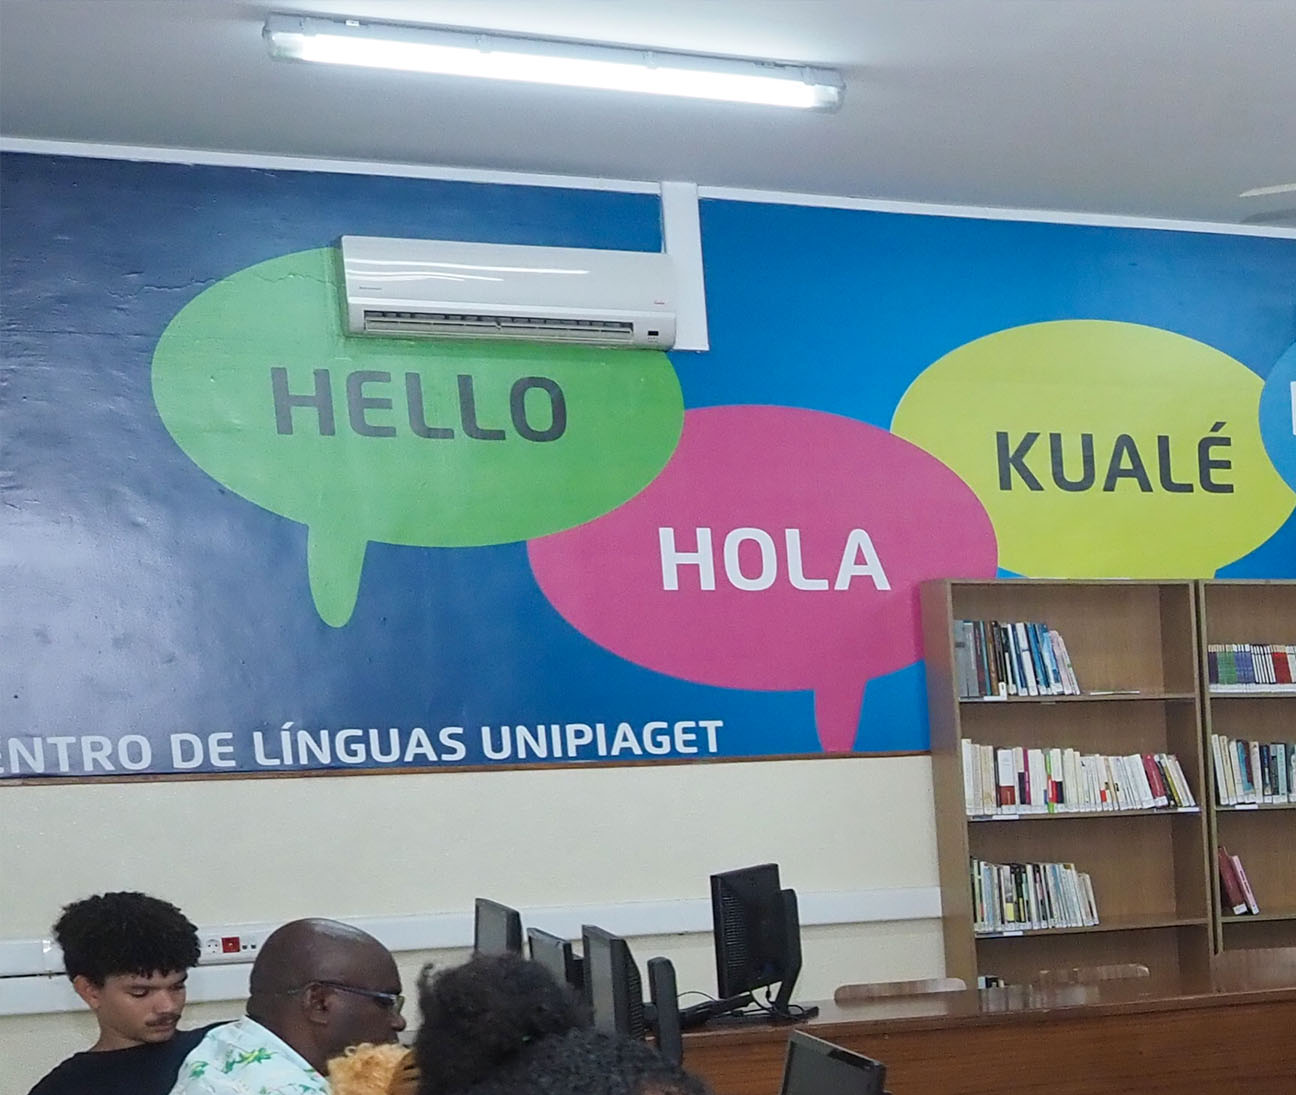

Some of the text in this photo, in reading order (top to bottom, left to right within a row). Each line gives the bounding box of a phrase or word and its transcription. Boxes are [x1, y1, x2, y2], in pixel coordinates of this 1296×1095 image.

[270, 366, 567, 443] HELLO
[995, 421, 1235, 494] KUALÉ
[659, 527, 891, 591] HOLA
[0, 720, 724, 773] NTRO DE LÍNGUAS UNIPIAGET
